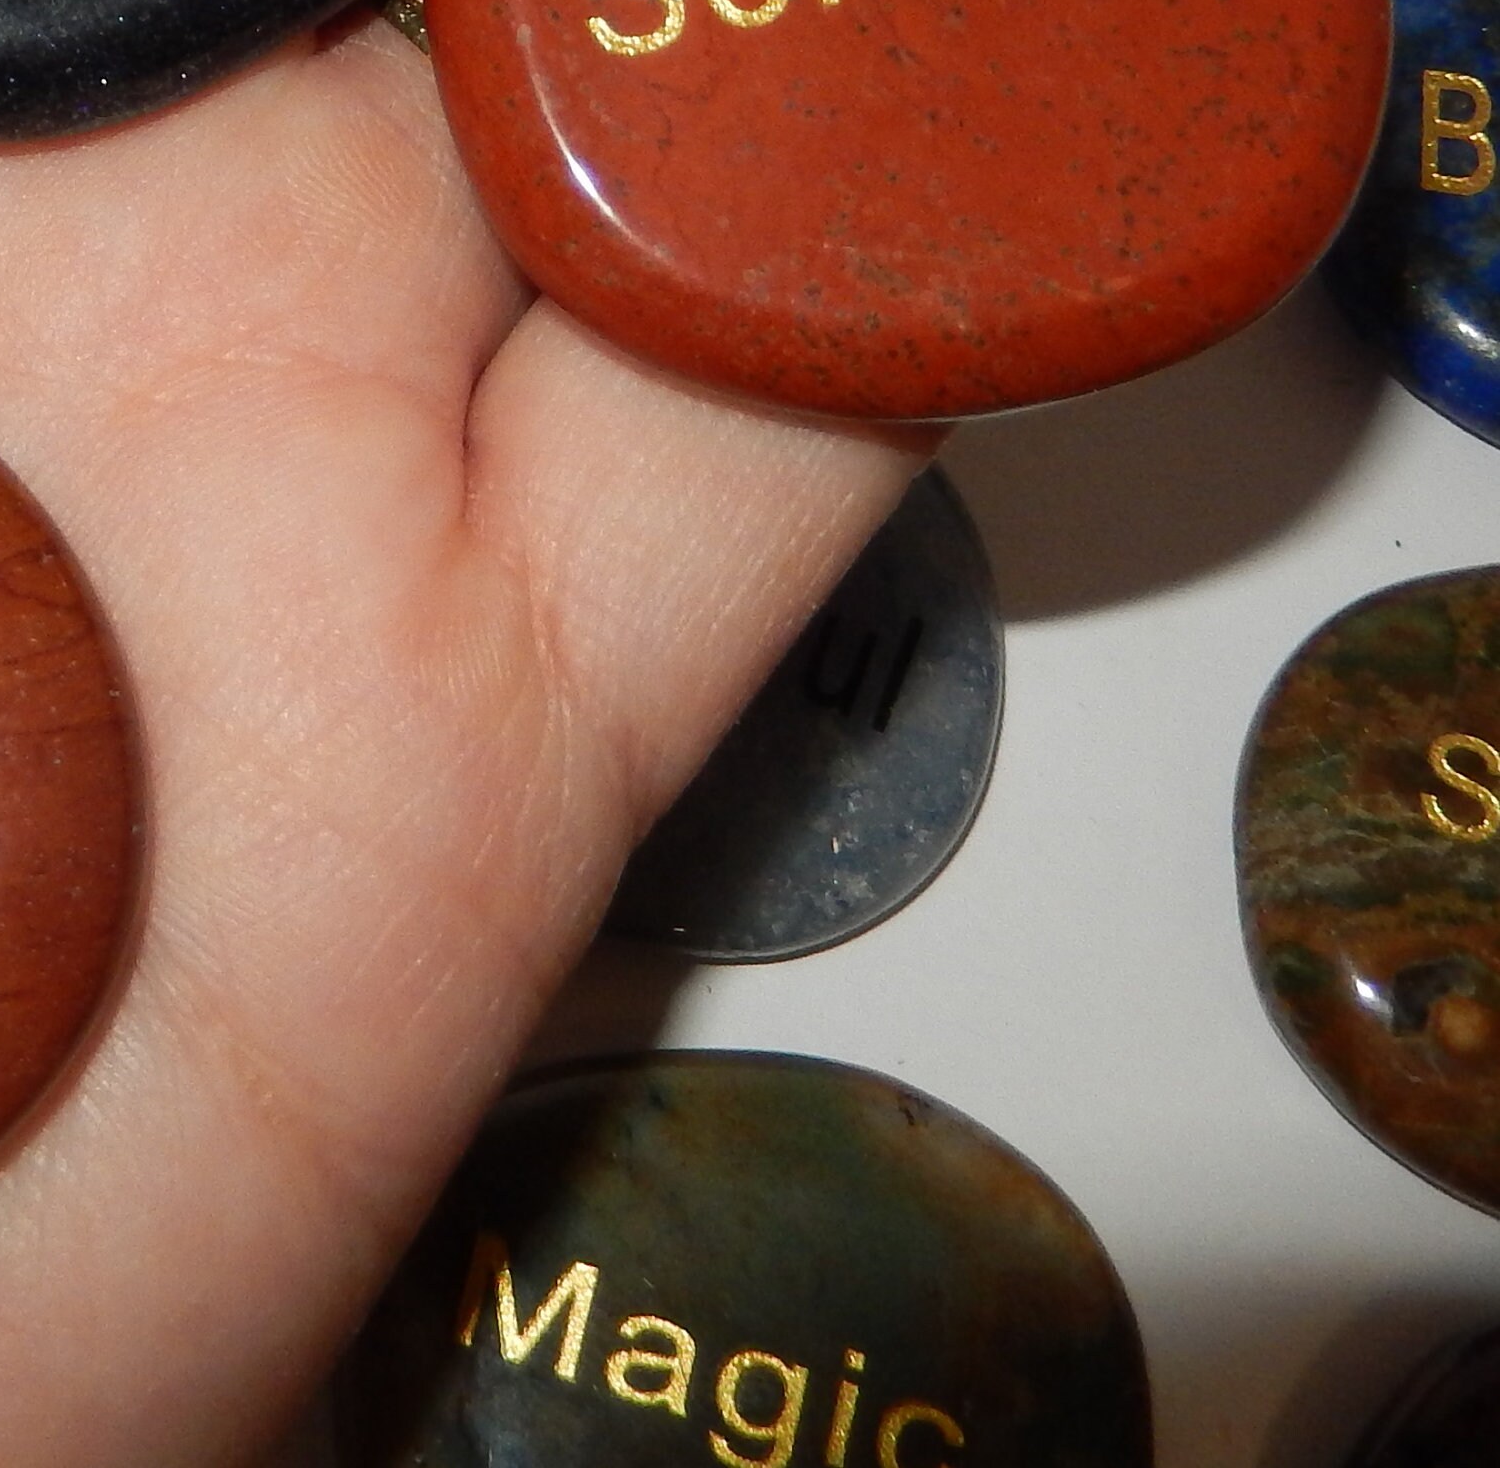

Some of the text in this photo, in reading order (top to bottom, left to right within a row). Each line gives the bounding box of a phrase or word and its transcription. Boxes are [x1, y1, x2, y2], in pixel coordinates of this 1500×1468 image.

[1420, 69, 1496, 196] B
[1421, 733, 1500, 842] S
[458, 1234, 965, 1468] Magic
